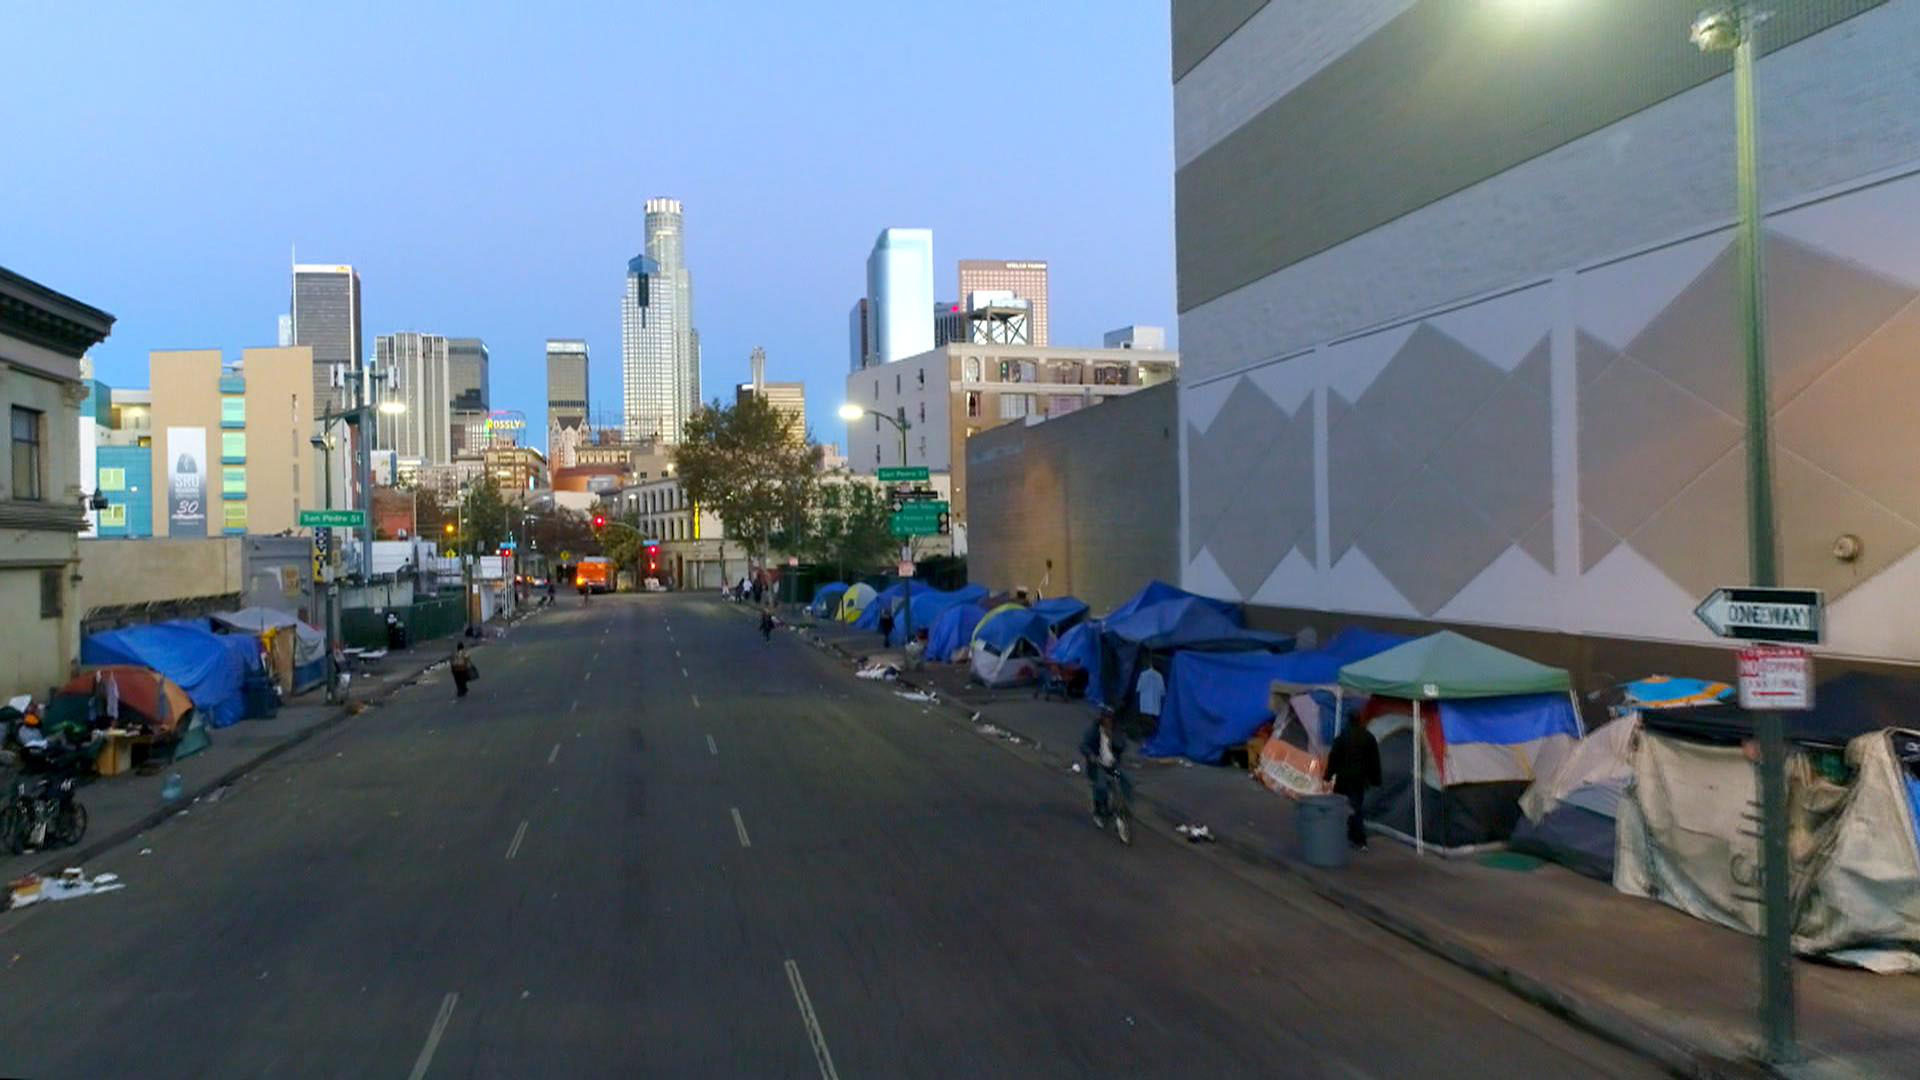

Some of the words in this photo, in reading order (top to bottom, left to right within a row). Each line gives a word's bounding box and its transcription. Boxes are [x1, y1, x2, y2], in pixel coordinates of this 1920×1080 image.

[176, 500, 199, 514] 30
[303, 514, 320, 522] San
[1728, 604, 1768, 624] ONE
